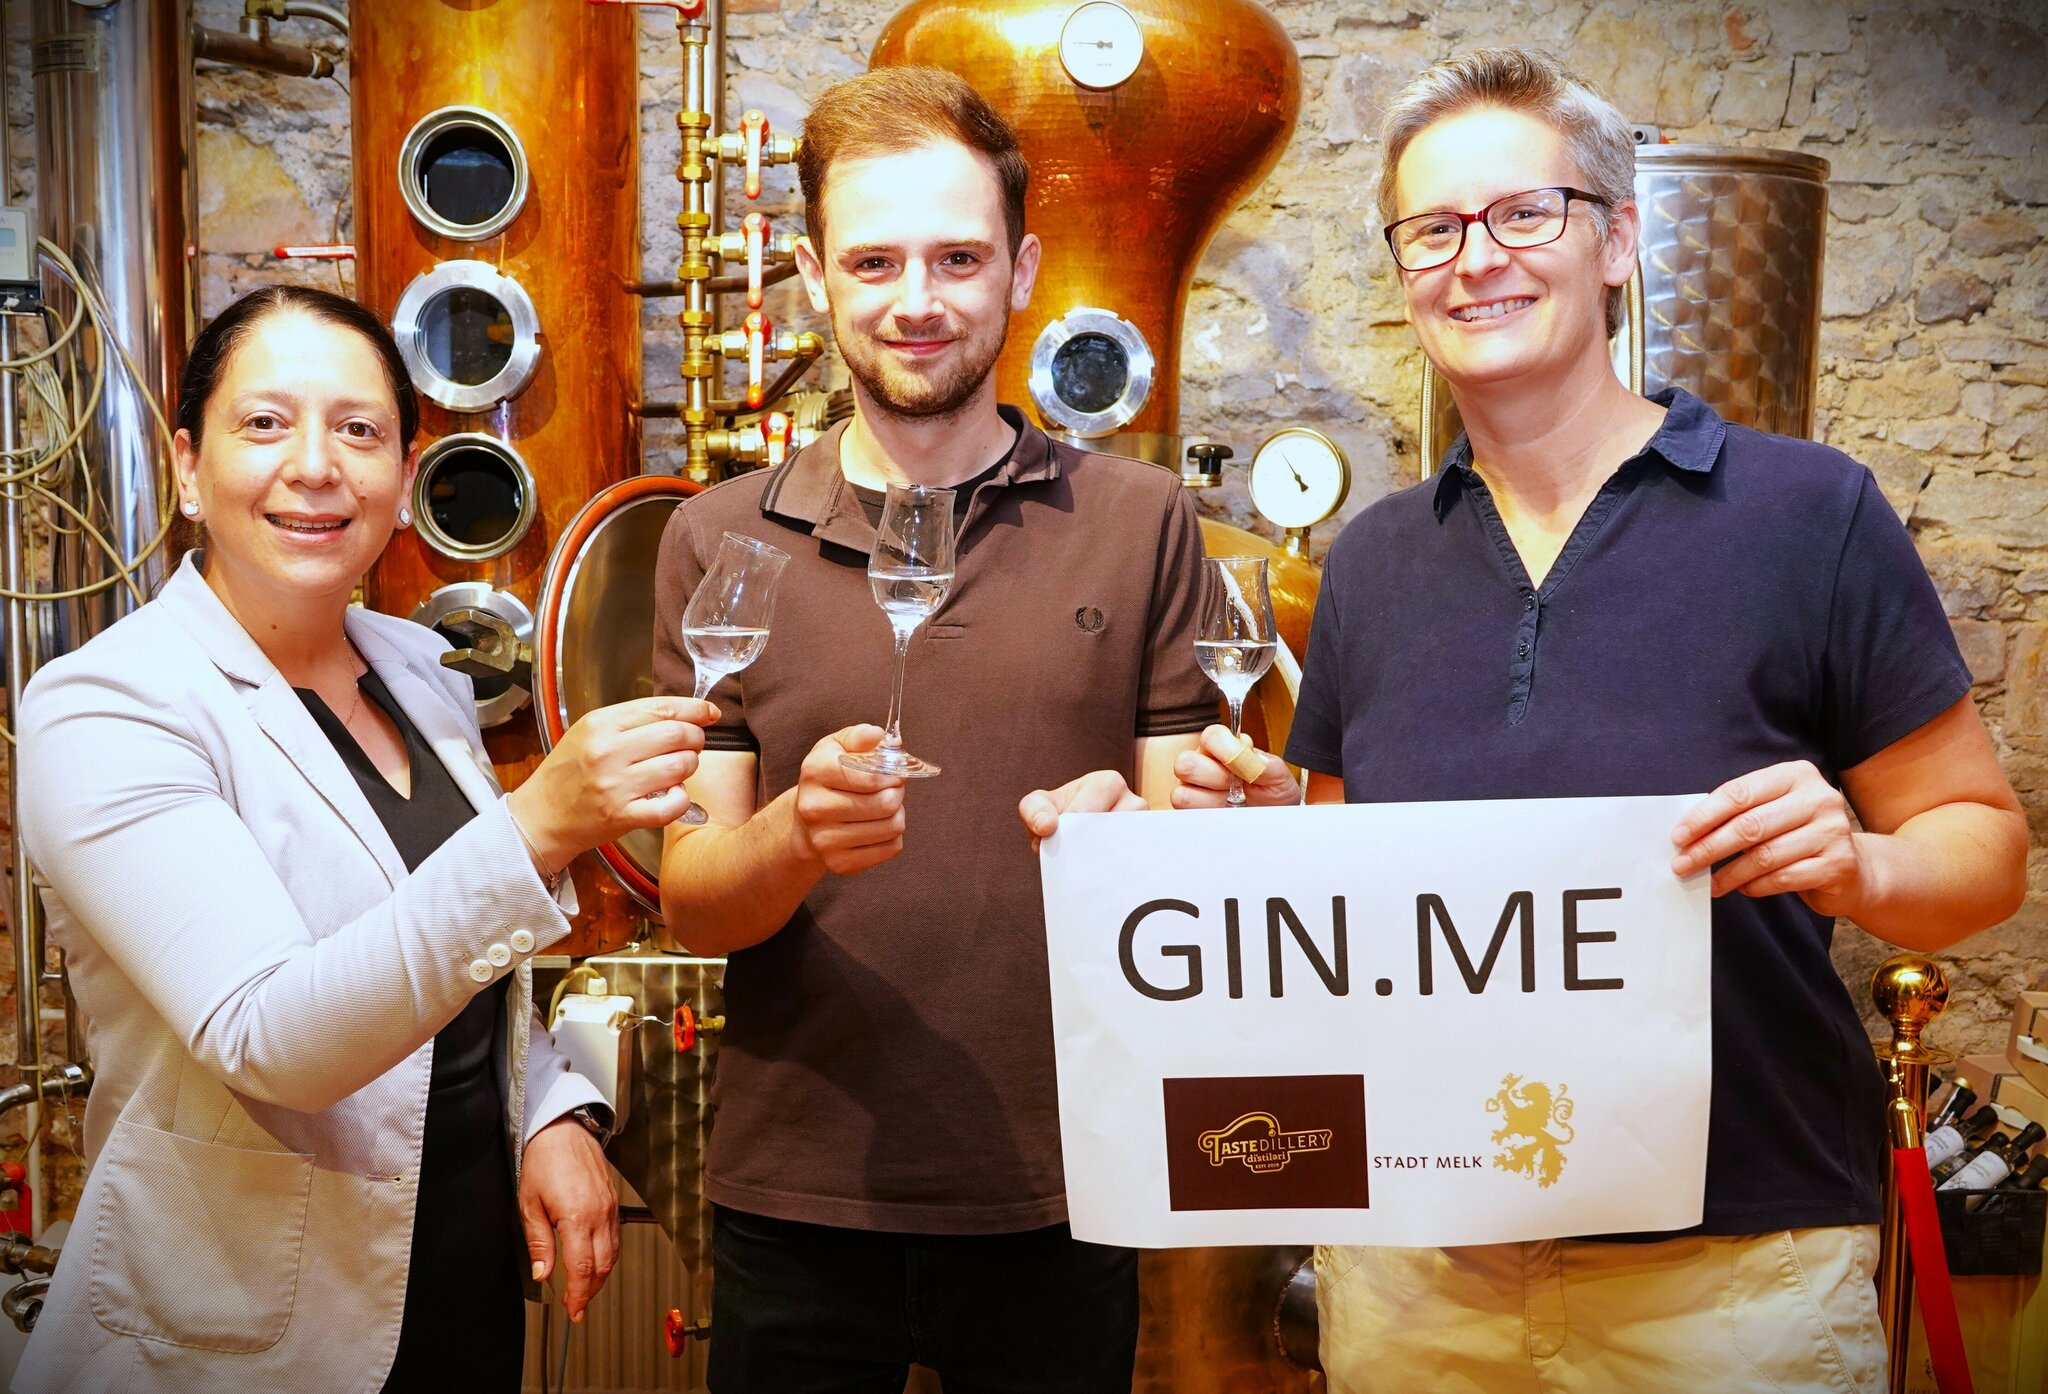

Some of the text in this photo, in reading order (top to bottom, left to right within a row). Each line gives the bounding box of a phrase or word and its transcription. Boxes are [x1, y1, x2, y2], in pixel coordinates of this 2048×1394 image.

[1117, 887, 1625, 1002] GIN.ME
[1202, 1116, 1328, 1162] TASTEDILLERY
[1373, 1155, 1483, 1169] STADT MELK
